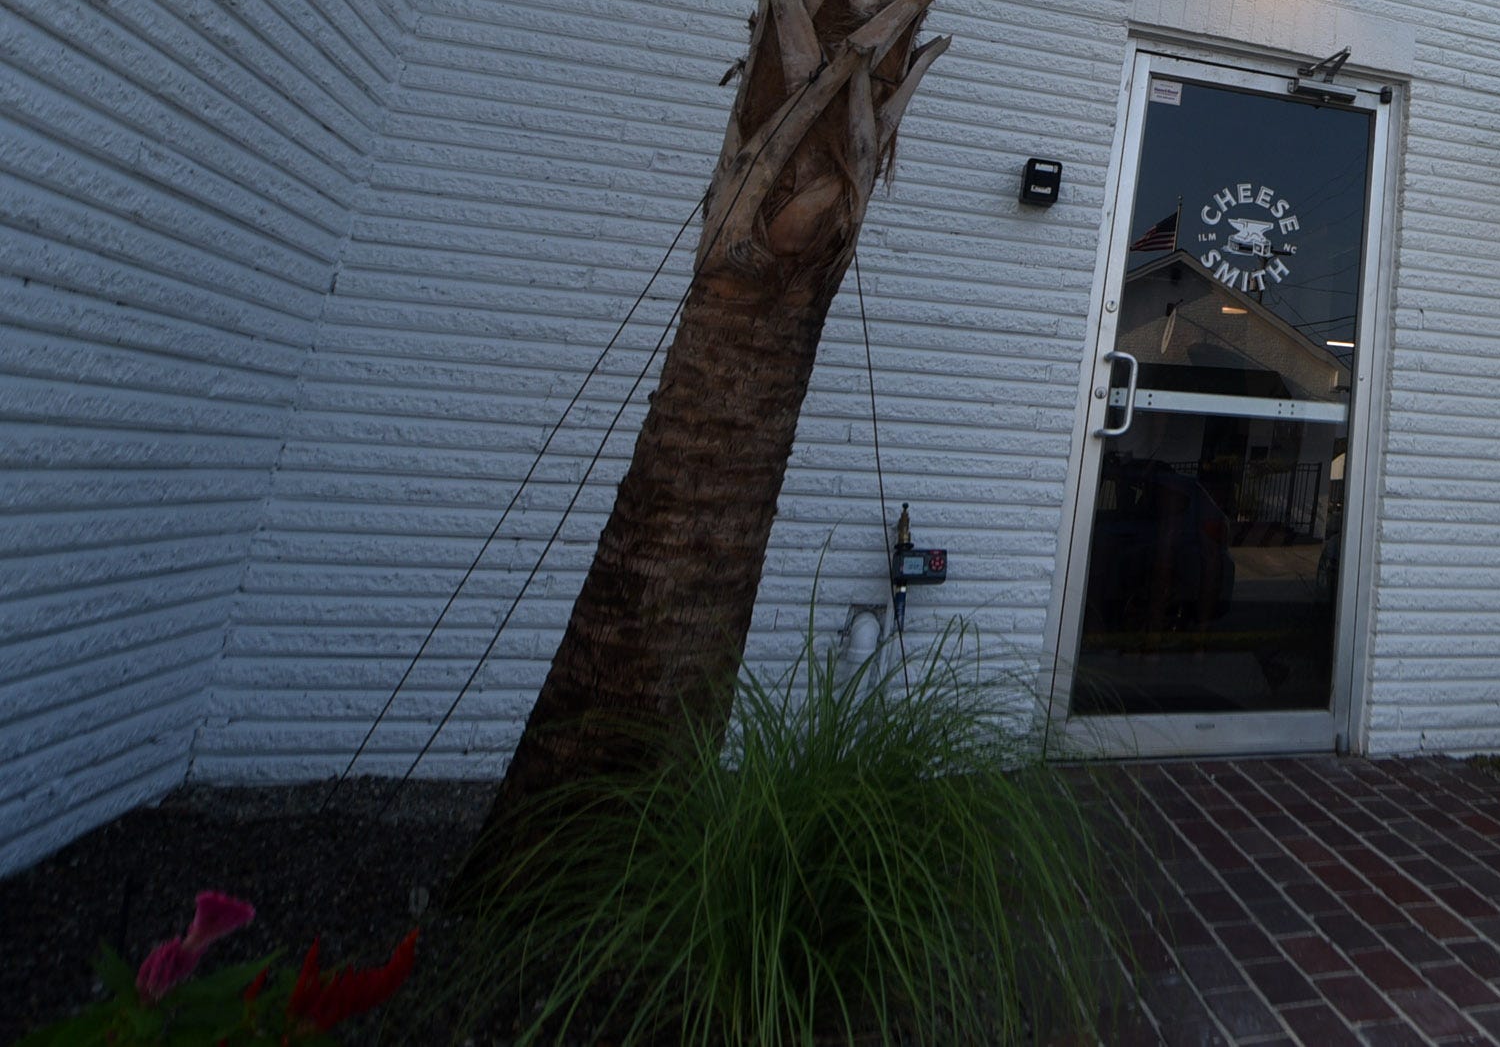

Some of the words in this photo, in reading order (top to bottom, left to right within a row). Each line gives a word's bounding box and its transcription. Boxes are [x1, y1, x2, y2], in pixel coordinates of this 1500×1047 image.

[1200, 183, 1300, 235] CHEESE
[1198, 232, 1217, 242] ILM
[1283, 243, 1298, 254] NC
[1200, 249, 1290, 292] SMITH
